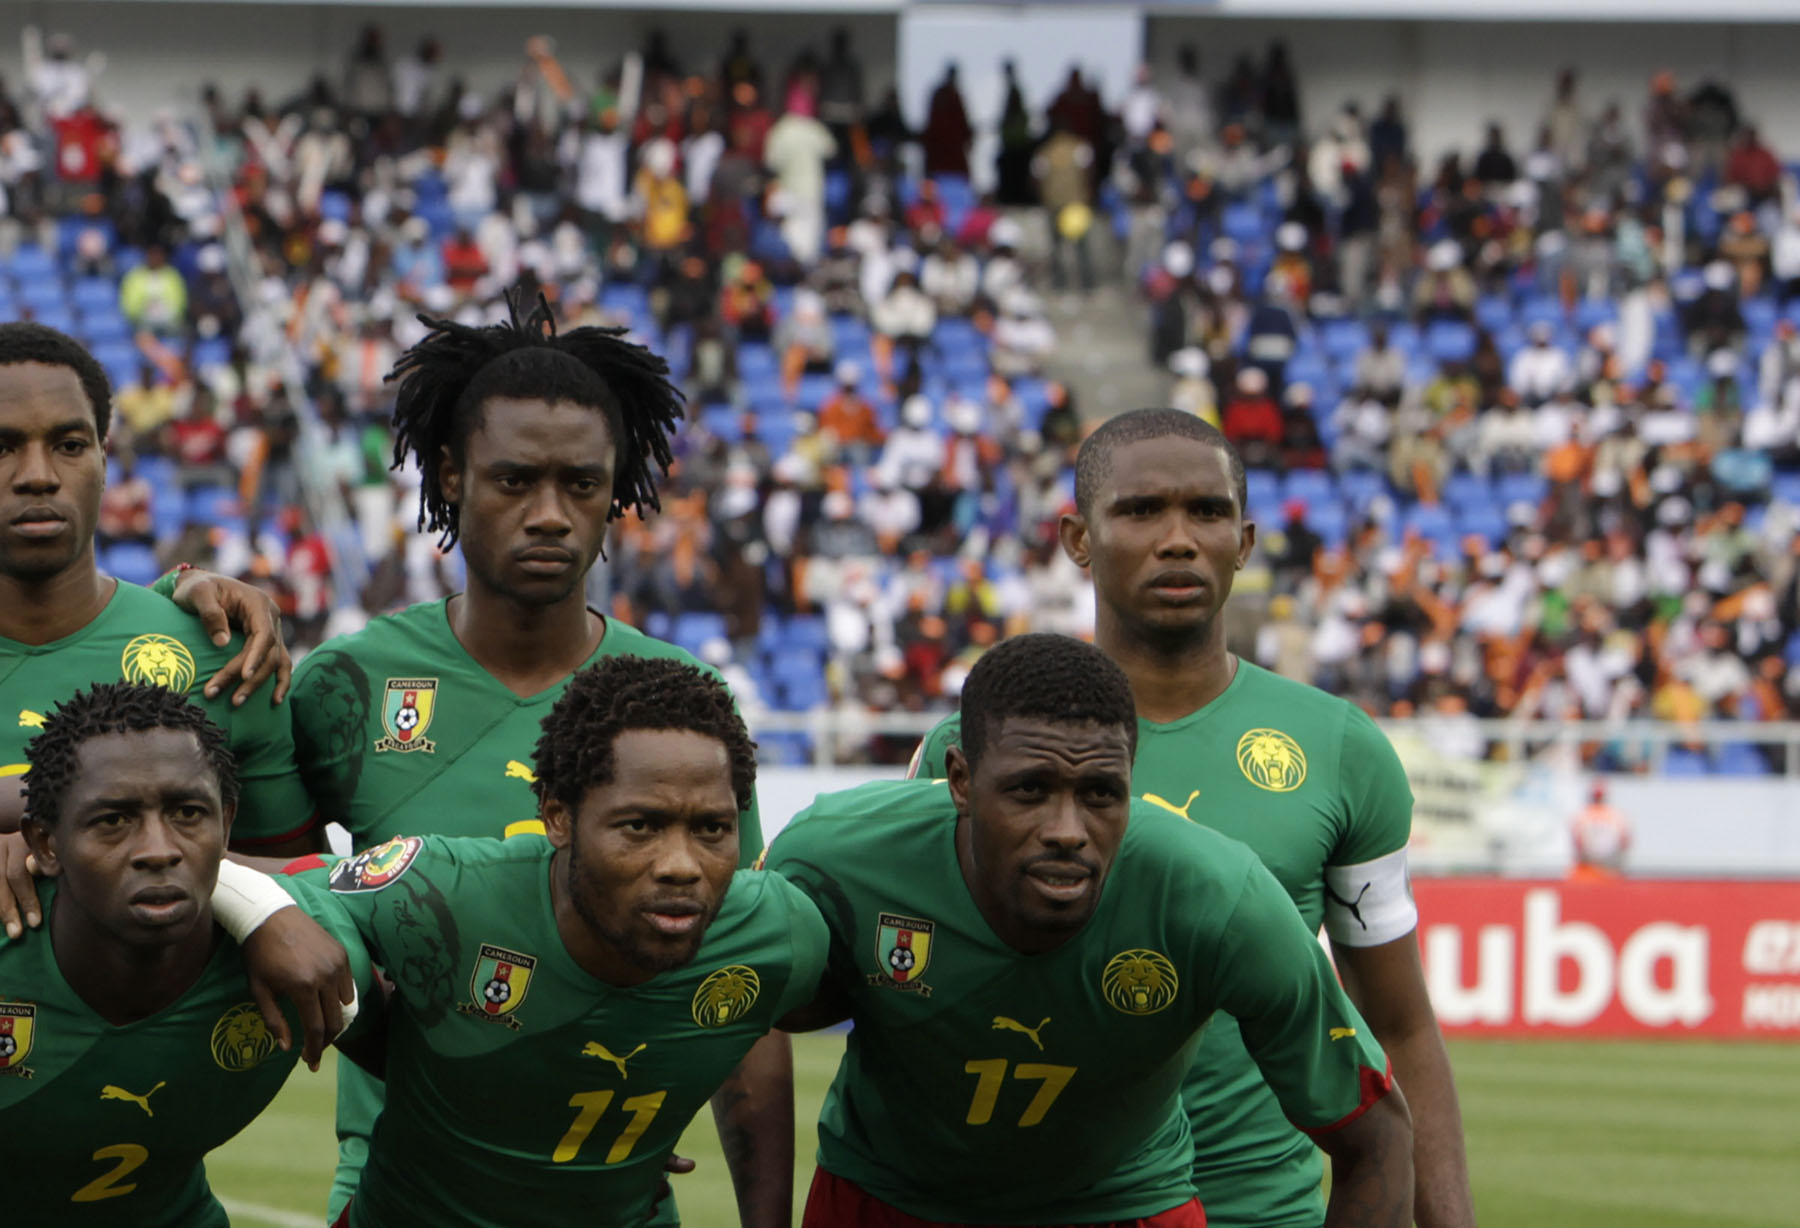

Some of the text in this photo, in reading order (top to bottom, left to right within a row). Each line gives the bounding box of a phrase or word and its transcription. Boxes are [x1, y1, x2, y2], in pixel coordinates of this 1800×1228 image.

[390, 681, 433, 689] CAMEROUN
[965, 1058, 1078, 1127] 17
[551, 1089, 667, 1164] 11
[71, 1143, 149, 1202] 2
